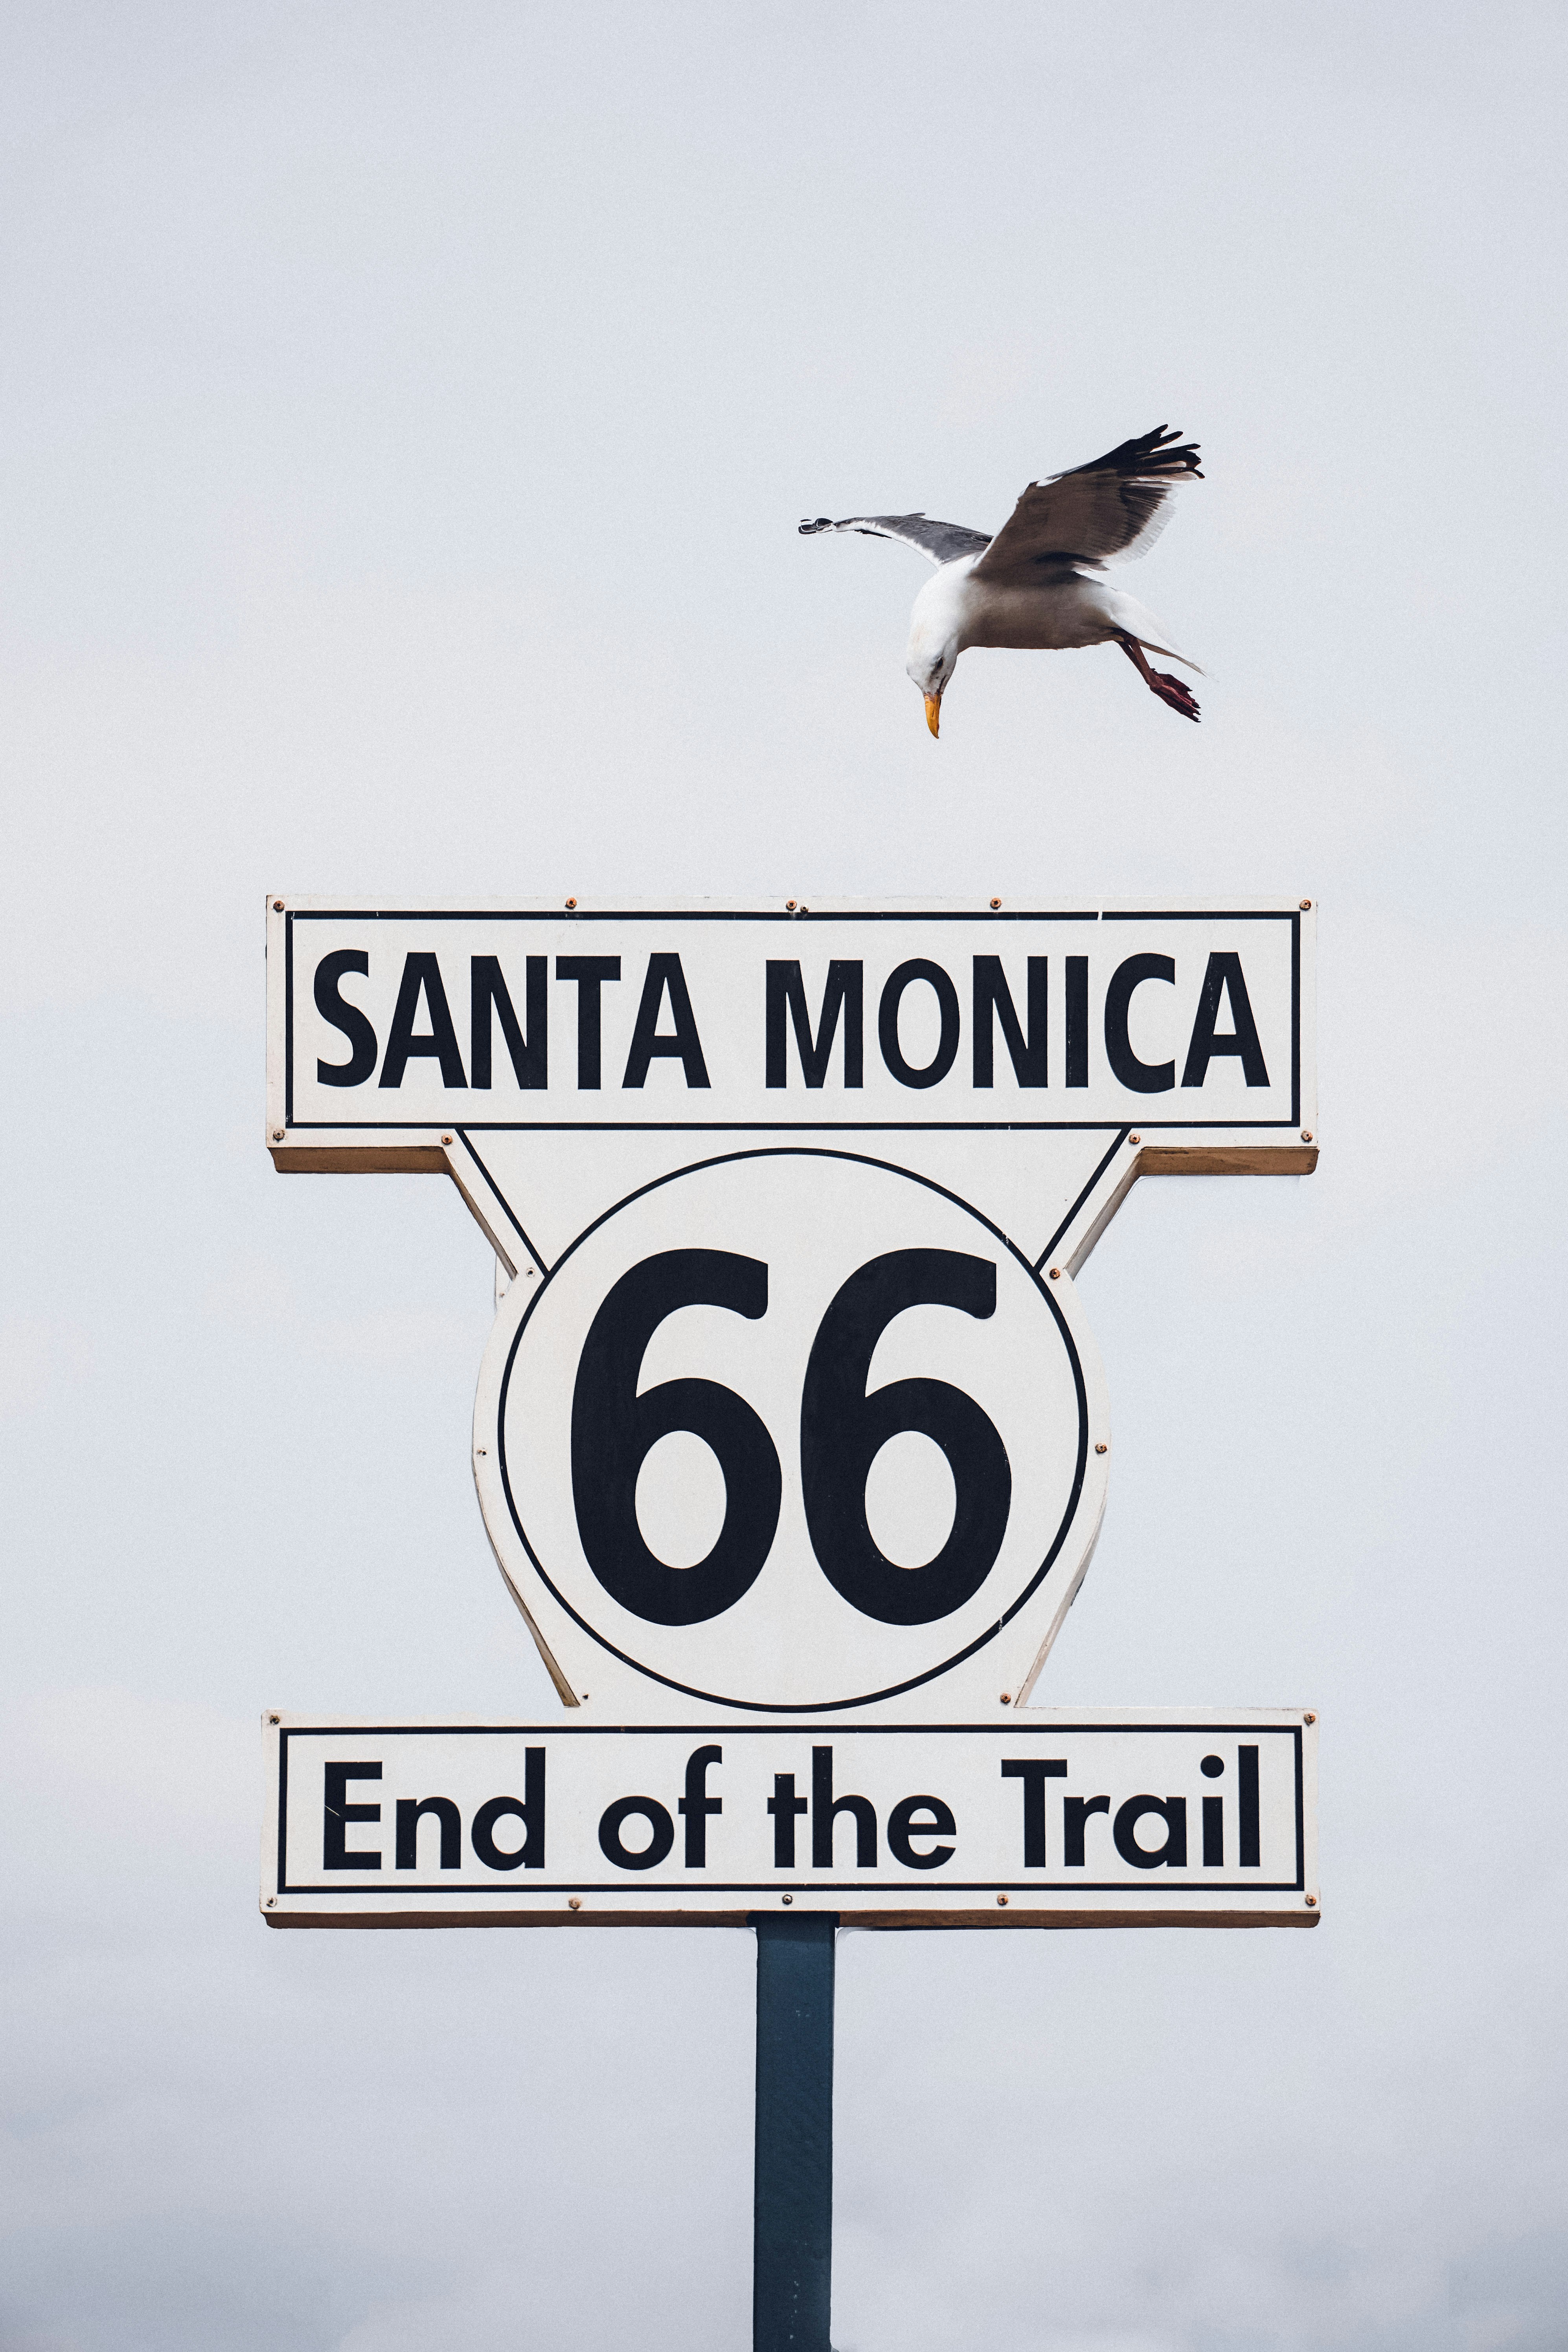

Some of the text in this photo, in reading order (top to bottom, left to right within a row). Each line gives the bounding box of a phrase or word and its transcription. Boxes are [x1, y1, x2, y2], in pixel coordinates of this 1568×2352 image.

[314, 950, 1270, 1093] SANTA MONICA
[571, 1248, 1011, 1626] 66
[324, 1745, 1260, 1871] End of the Trail
